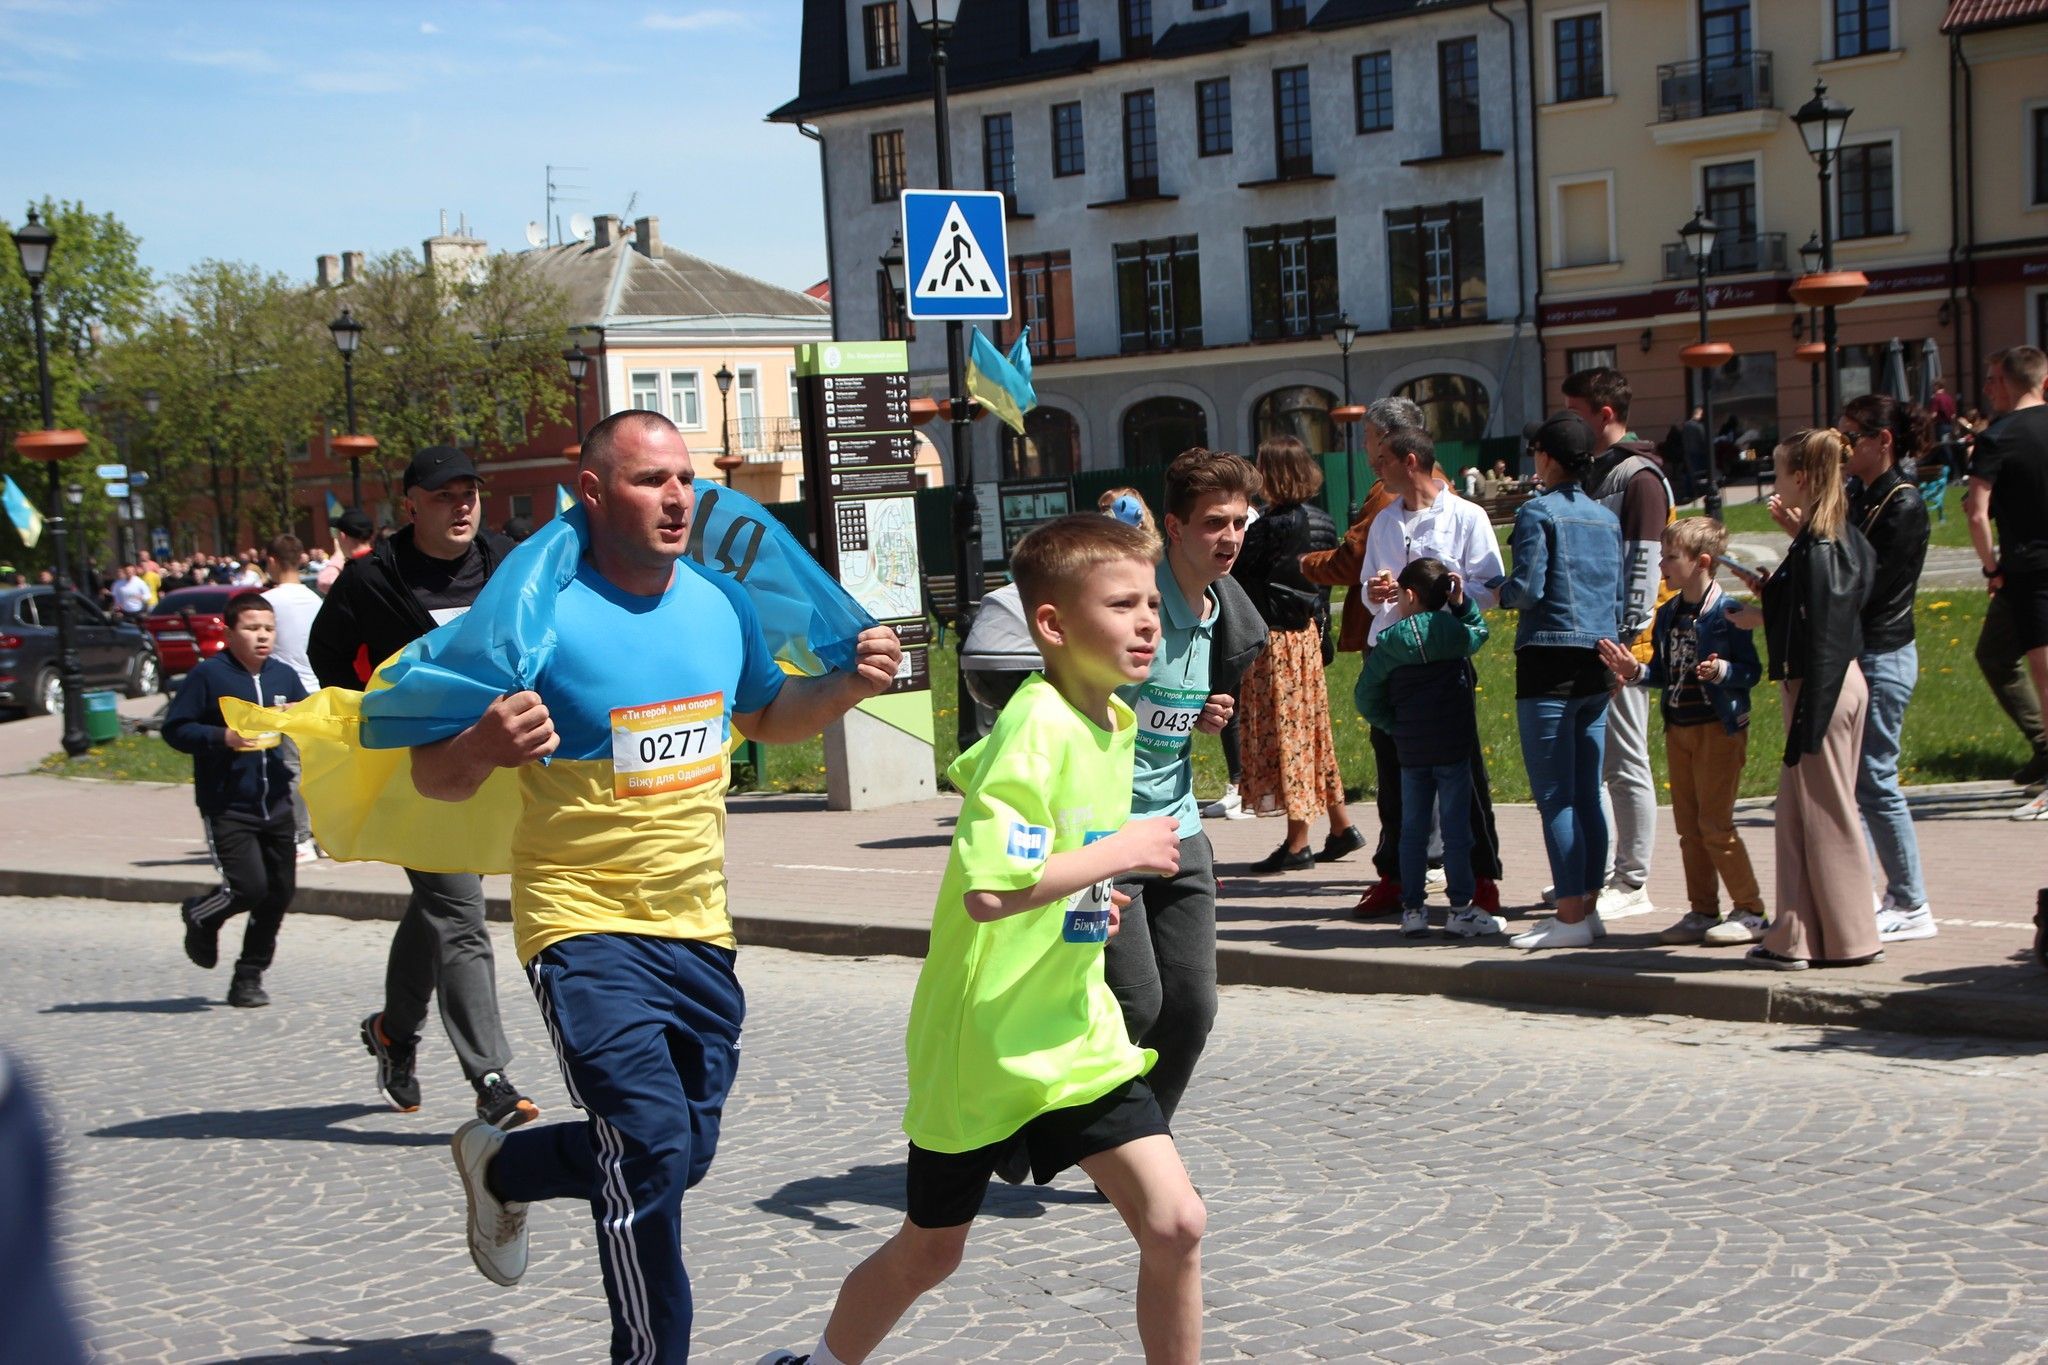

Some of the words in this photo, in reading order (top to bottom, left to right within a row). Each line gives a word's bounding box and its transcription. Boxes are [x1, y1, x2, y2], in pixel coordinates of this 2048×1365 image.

[639, 727, 708, 763] 0277
[628, 777, 653, 788] Біжу
[656, 774, 675, 786] для
[1073, 918, 1094, 934] Біжу
